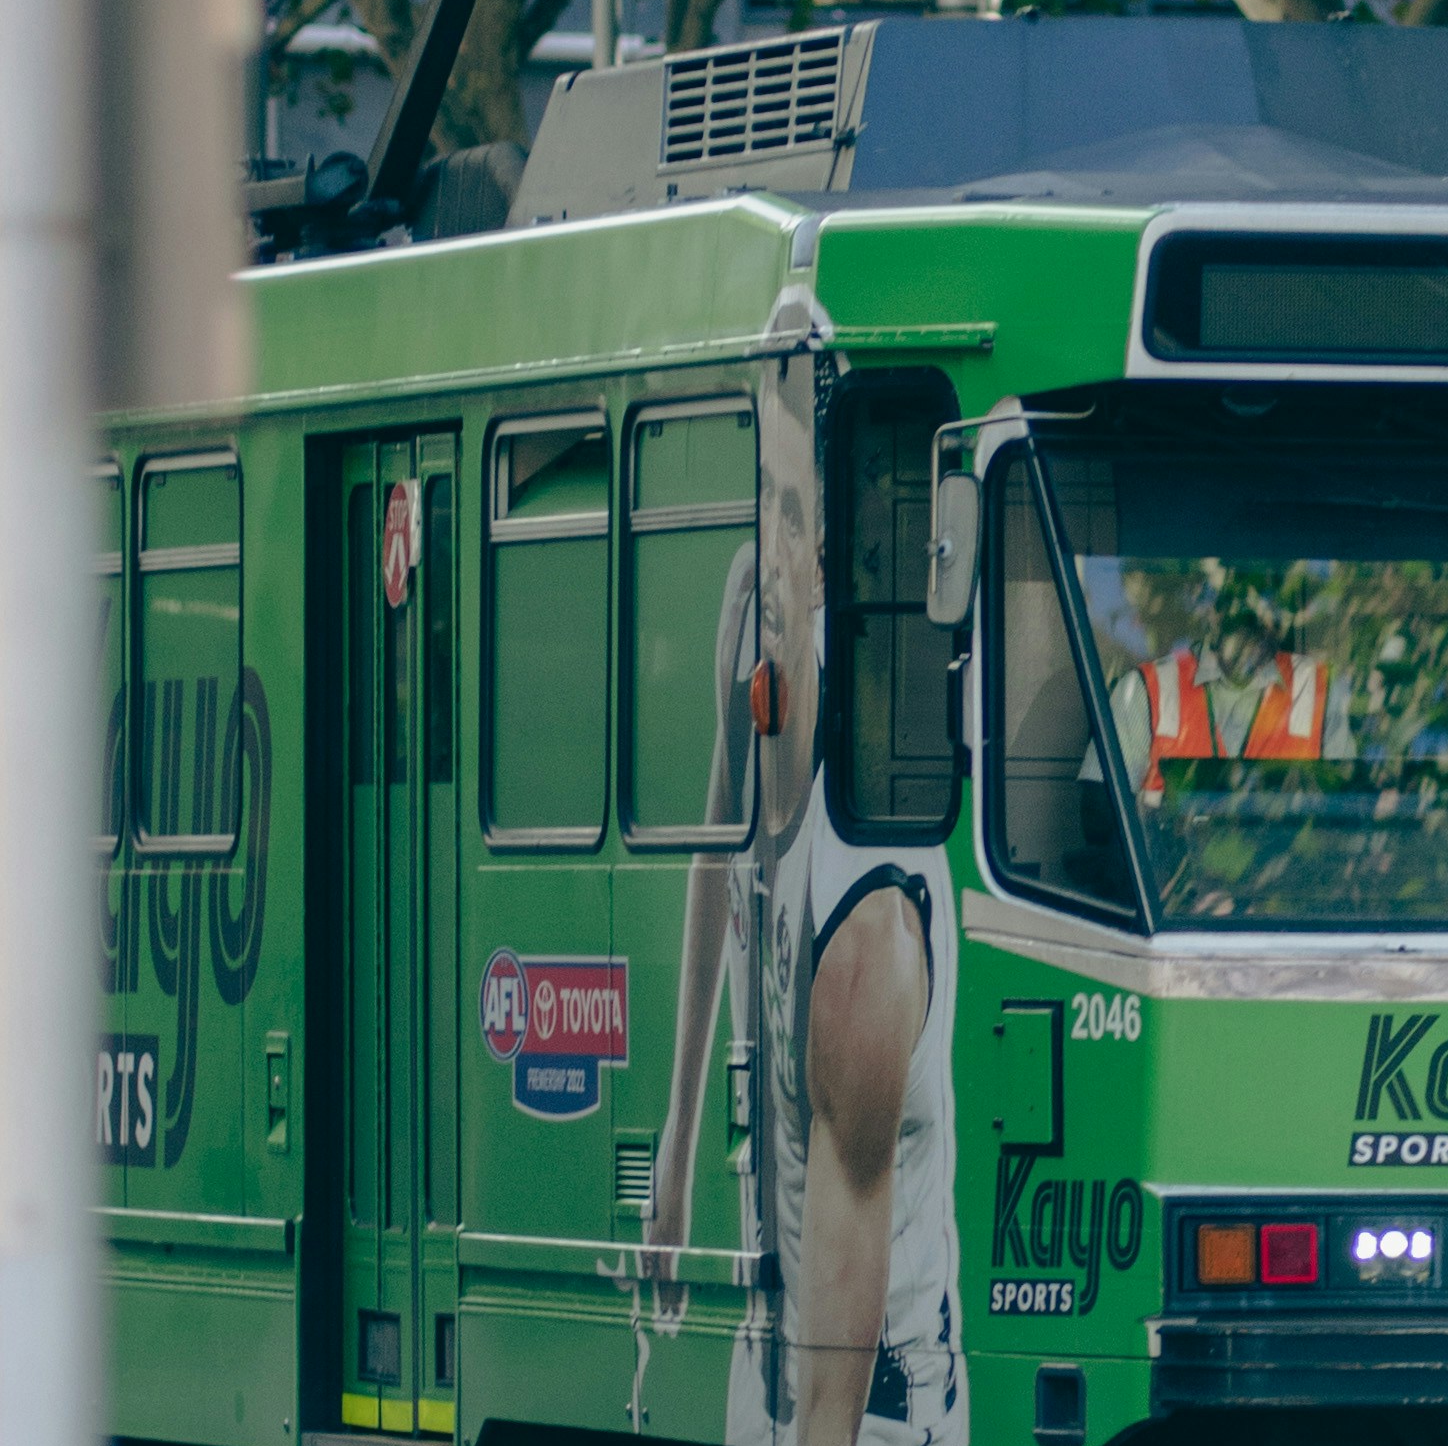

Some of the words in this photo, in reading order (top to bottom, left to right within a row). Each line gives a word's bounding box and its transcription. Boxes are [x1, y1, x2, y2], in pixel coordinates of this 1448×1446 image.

[86, 598, 273, 1169] ayo
[484, 977, 525, 1031] AFL
[560, 988, 623, 1034] TOYOTA
[1071, 993, 1141, 1041] 2046
[992, 1155, 1144, 1316] Kayo
[991, 1281, 1073, 1313] SPORTS
